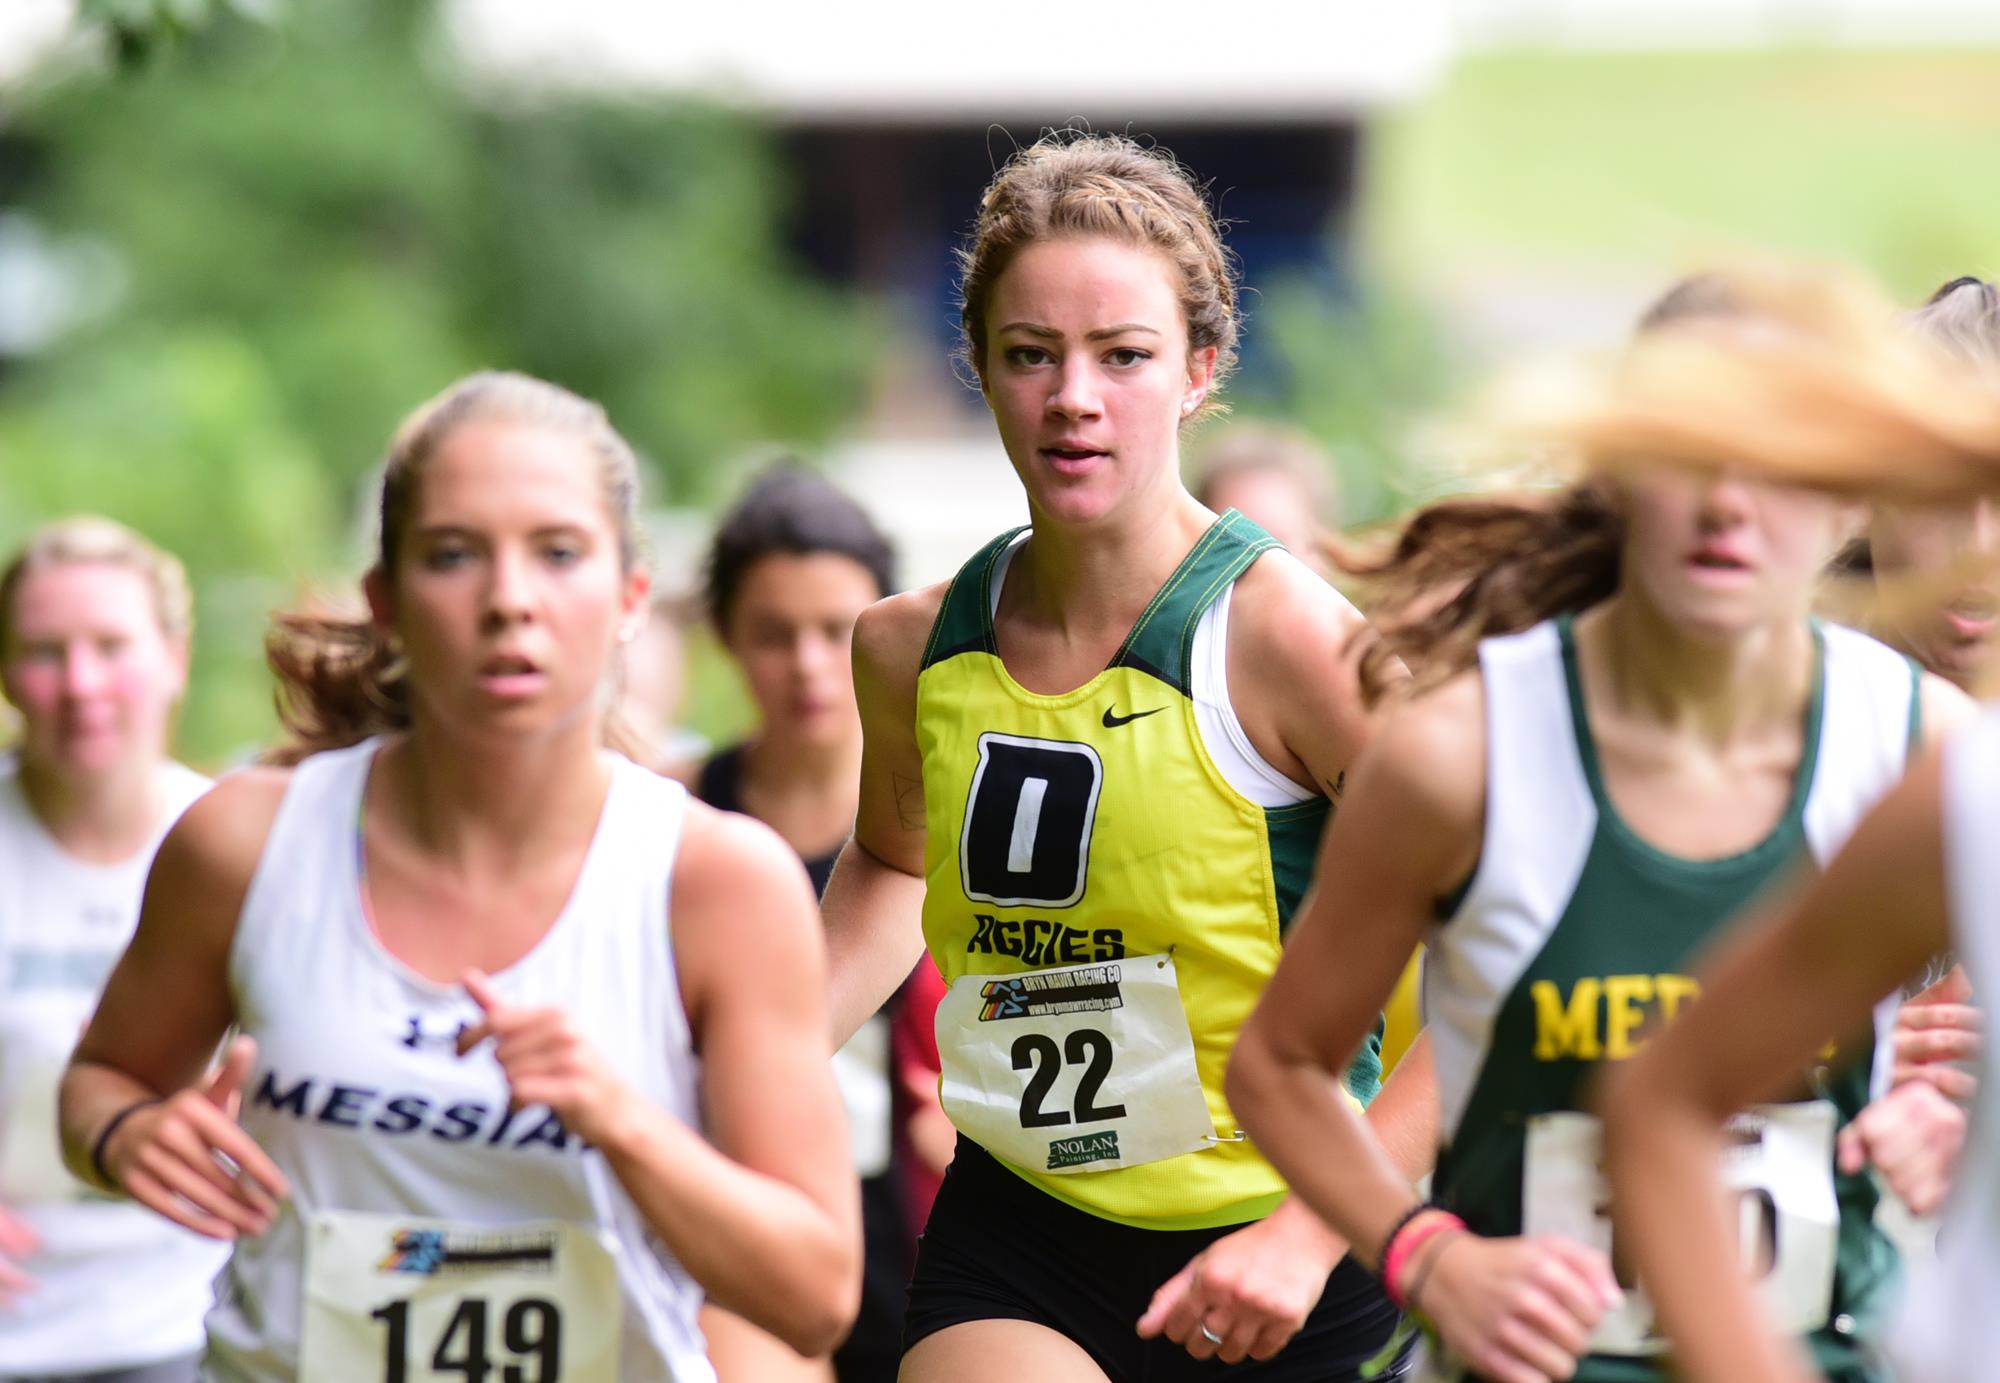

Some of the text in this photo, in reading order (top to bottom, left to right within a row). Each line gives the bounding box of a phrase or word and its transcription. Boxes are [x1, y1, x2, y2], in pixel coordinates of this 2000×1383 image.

[967, 914, 1125, 966] AGGIES
[1022, 964, 1121, 991] BRYN MAWR RACING CO
[1027, 996, 1122, 1016] www.brynmawrracing.com
[1011, 1029, 1126, 1128] 22
[253, 1070, 598, 1152] MESSIA
[1056, 1136, 1114, 1155] NOLAN
[370, 1296, 562, 1383] 149
